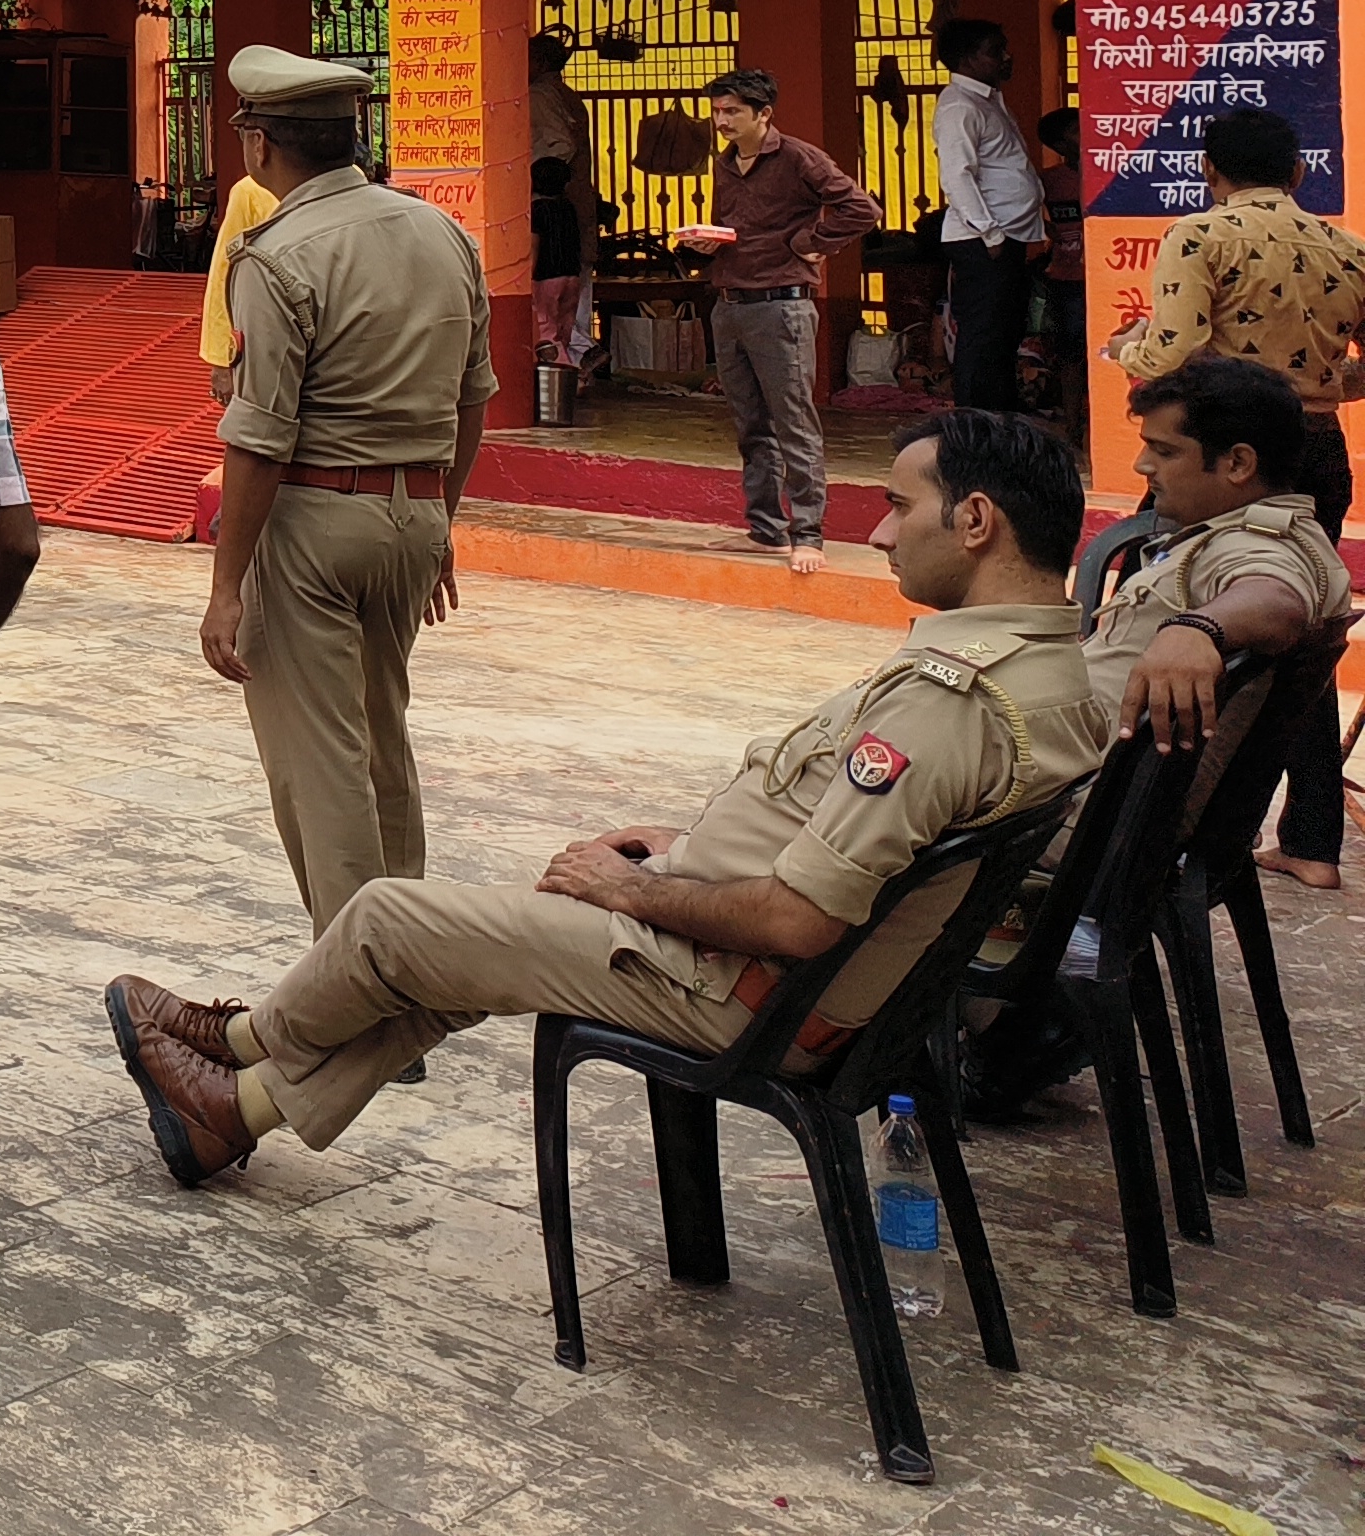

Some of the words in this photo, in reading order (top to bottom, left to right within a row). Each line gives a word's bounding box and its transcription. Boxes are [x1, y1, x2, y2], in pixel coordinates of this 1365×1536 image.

[397, 5, 423, 29] की
[396, 36, 438, 57] सुरक्षा
[1086, 35, 1156, 70] किसी
[1156, 34, 1192, 69] भी
[1191, 33, 1327, 70] आकस्मिक
[430, 56, 449, 81] भी
[448, 62, 478, 81] प्रकार
[393, 85, 413, 110] की
[414, 90, 448, 109] घटना
[448, 84, 474, 111] होने
[1121, 78, 1219, 109] सहायता
[1219, 72, 1269, 108] हेतु
[411, 114, 445, 139] मन्दिर
[393, 141, 441, 165] जिम्मेदार
[440, 140, 461, 170] नहीं
[459, 139, 482, 168] होगा
[1087, 141, 1159, 180] महिला
[1158, 148, 1207, 178] सहा
[433, 184, 478, 205] CCTV
